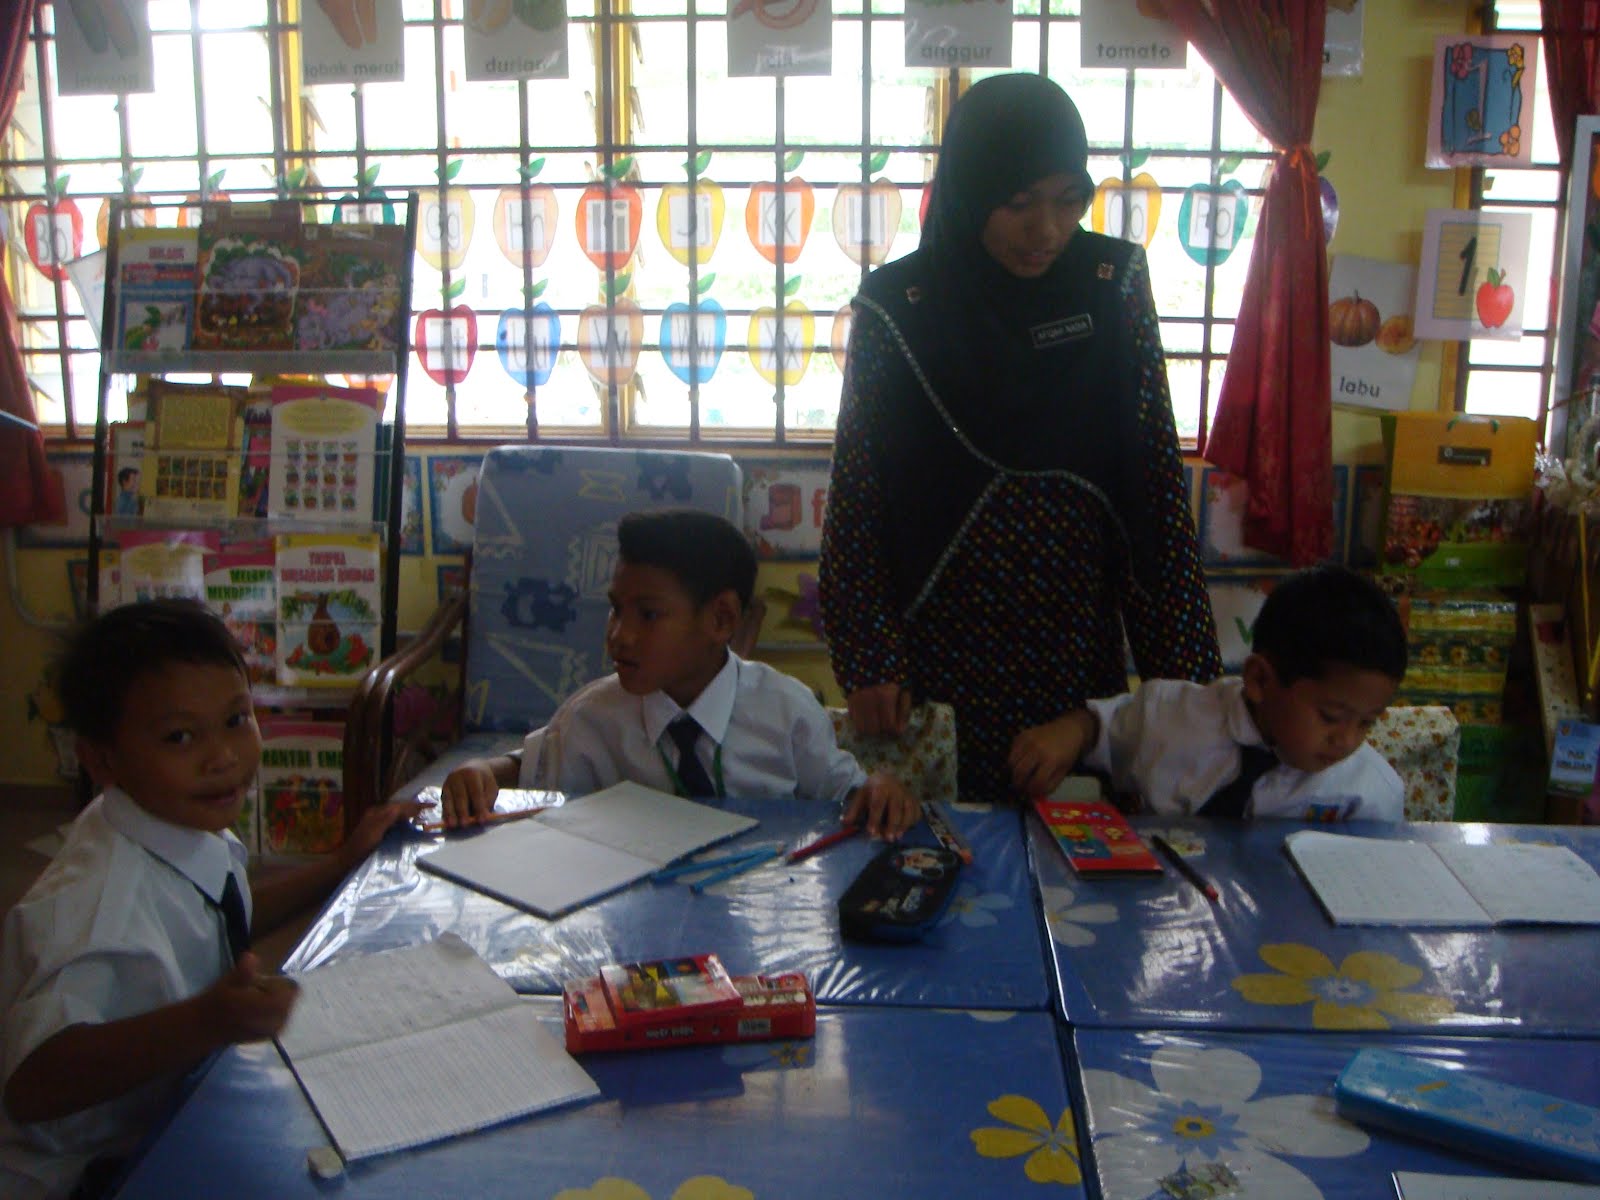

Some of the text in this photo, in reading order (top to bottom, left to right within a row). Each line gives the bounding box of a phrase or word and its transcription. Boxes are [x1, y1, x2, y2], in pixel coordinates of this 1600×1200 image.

[920, 43, 993, 63] anggur
[1096, 41, 1172, 60] tomato
[353, 59, 402, 76] merah
[1338, 376, 1379, 398] labu
